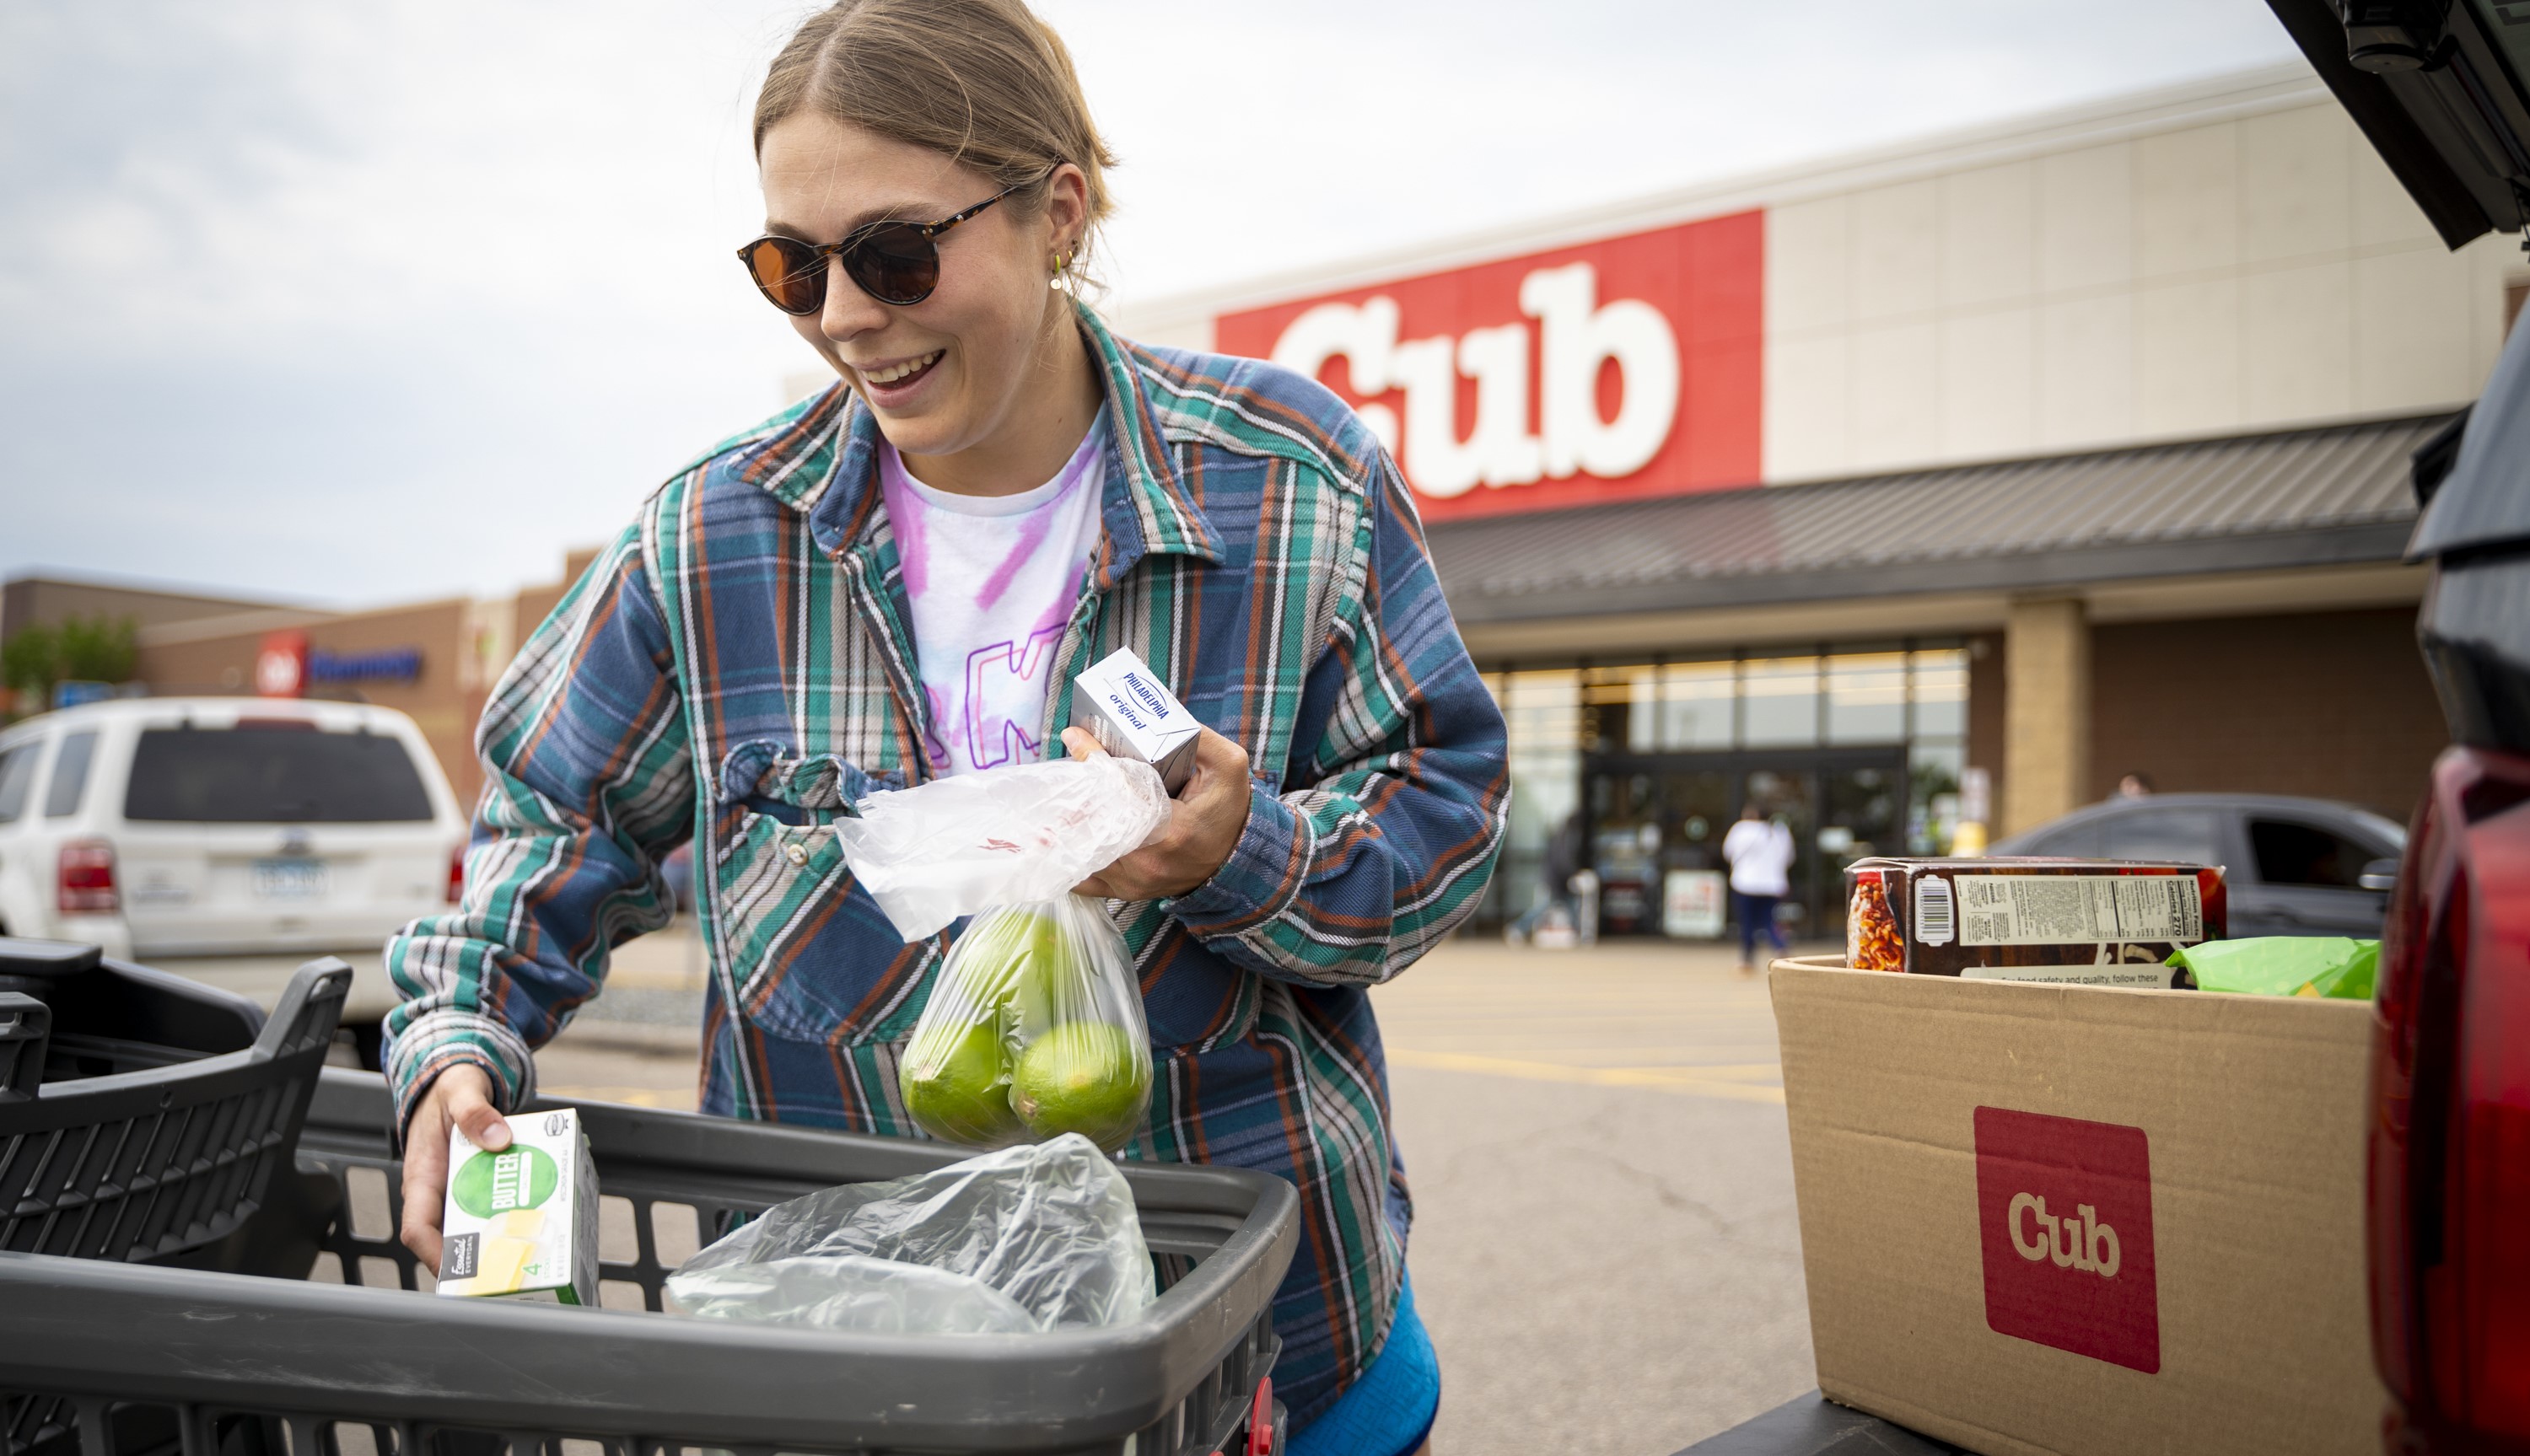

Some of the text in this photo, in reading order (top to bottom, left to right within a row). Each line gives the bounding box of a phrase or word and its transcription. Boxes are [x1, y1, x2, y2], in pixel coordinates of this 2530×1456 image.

[1269, 261, 1680, 497] Cub
[1110, 695, 1146, 729] original
[1123, 673, 1169, 719] PHILADELPHIA
[2066, 975, 2081, 984] and
[2083, 975, 2110, 985] quality,
[2113, 975, 2135, 983] follow
[492, 1153, 519, 1210] BUTTER
[2009, 1192, 2120, 1277] Cub
[452, 1238, 466, 1275] Essential
[523, 1263, 541, 1276] 4
